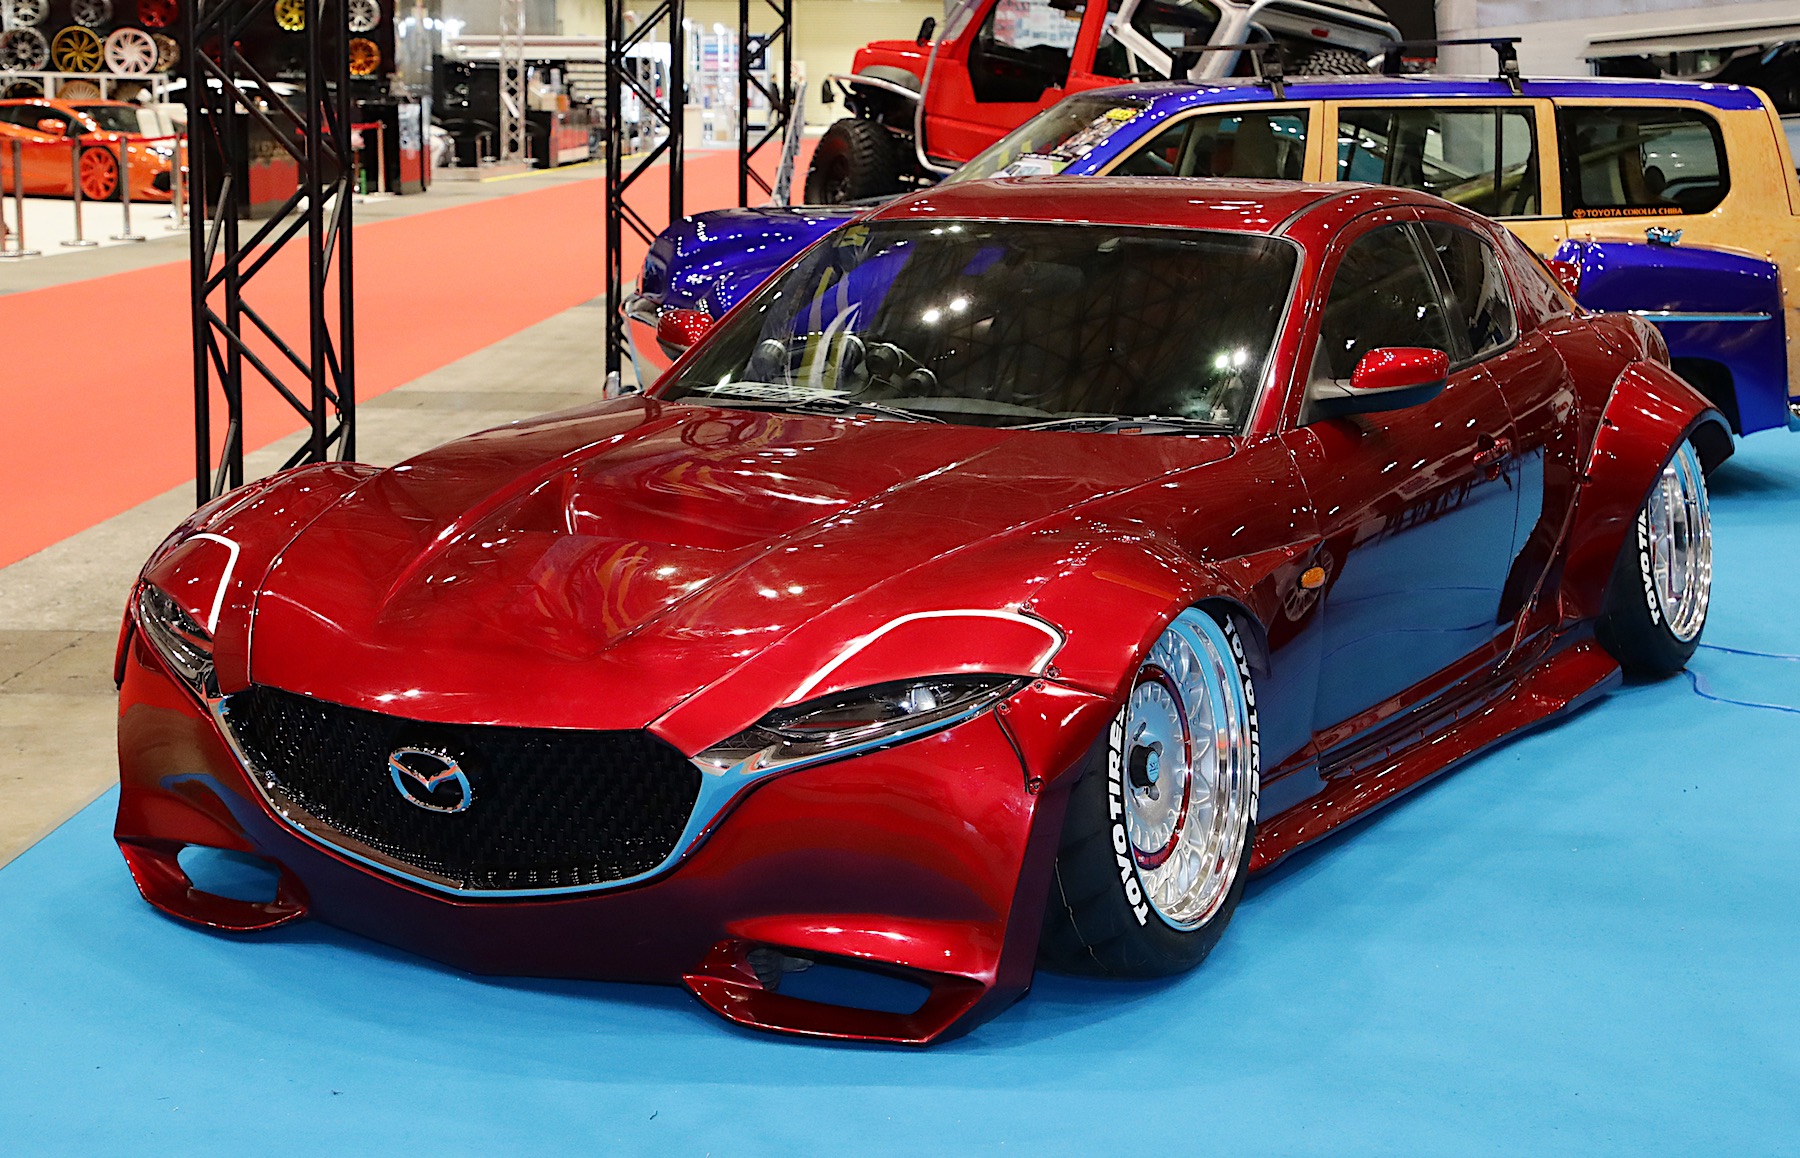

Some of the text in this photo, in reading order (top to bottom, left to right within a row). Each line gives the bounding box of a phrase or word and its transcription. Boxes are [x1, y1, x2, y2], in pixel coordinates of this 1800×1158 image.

[1586, 206, 1684, 217] TOYOTA COROLLA CHIBA
[1640, 552, 1661, 625] TOYO
[1224, 613, 1260, 825] TOYO TIRES
[1112, 823, 1148, 926] TOYO
